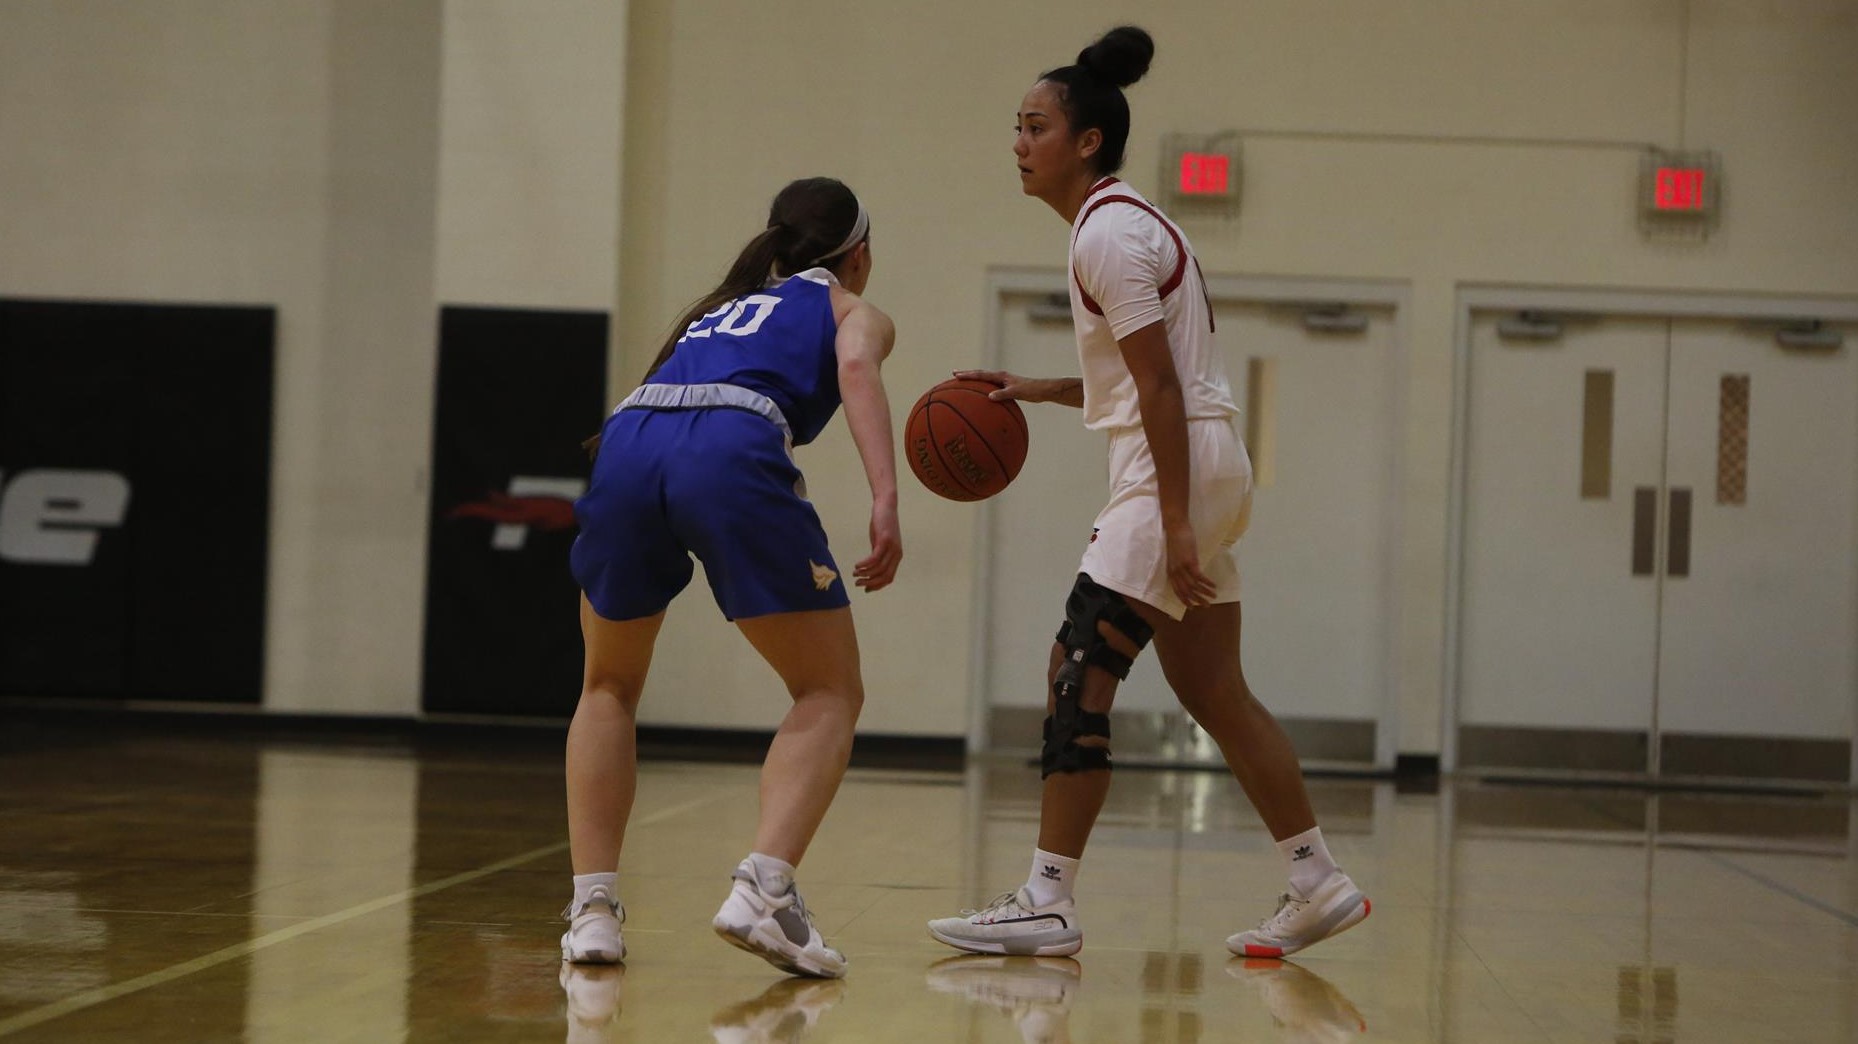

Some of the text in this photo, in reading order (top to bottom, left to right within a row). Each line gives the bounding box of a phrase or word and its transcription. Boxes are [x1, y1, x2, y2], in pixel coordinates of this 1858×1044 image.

[1181, 153, 1229, 194] EXIT
[1656, 168, 1704, 210] EXIT
[677, 295, 783, 343] 20
